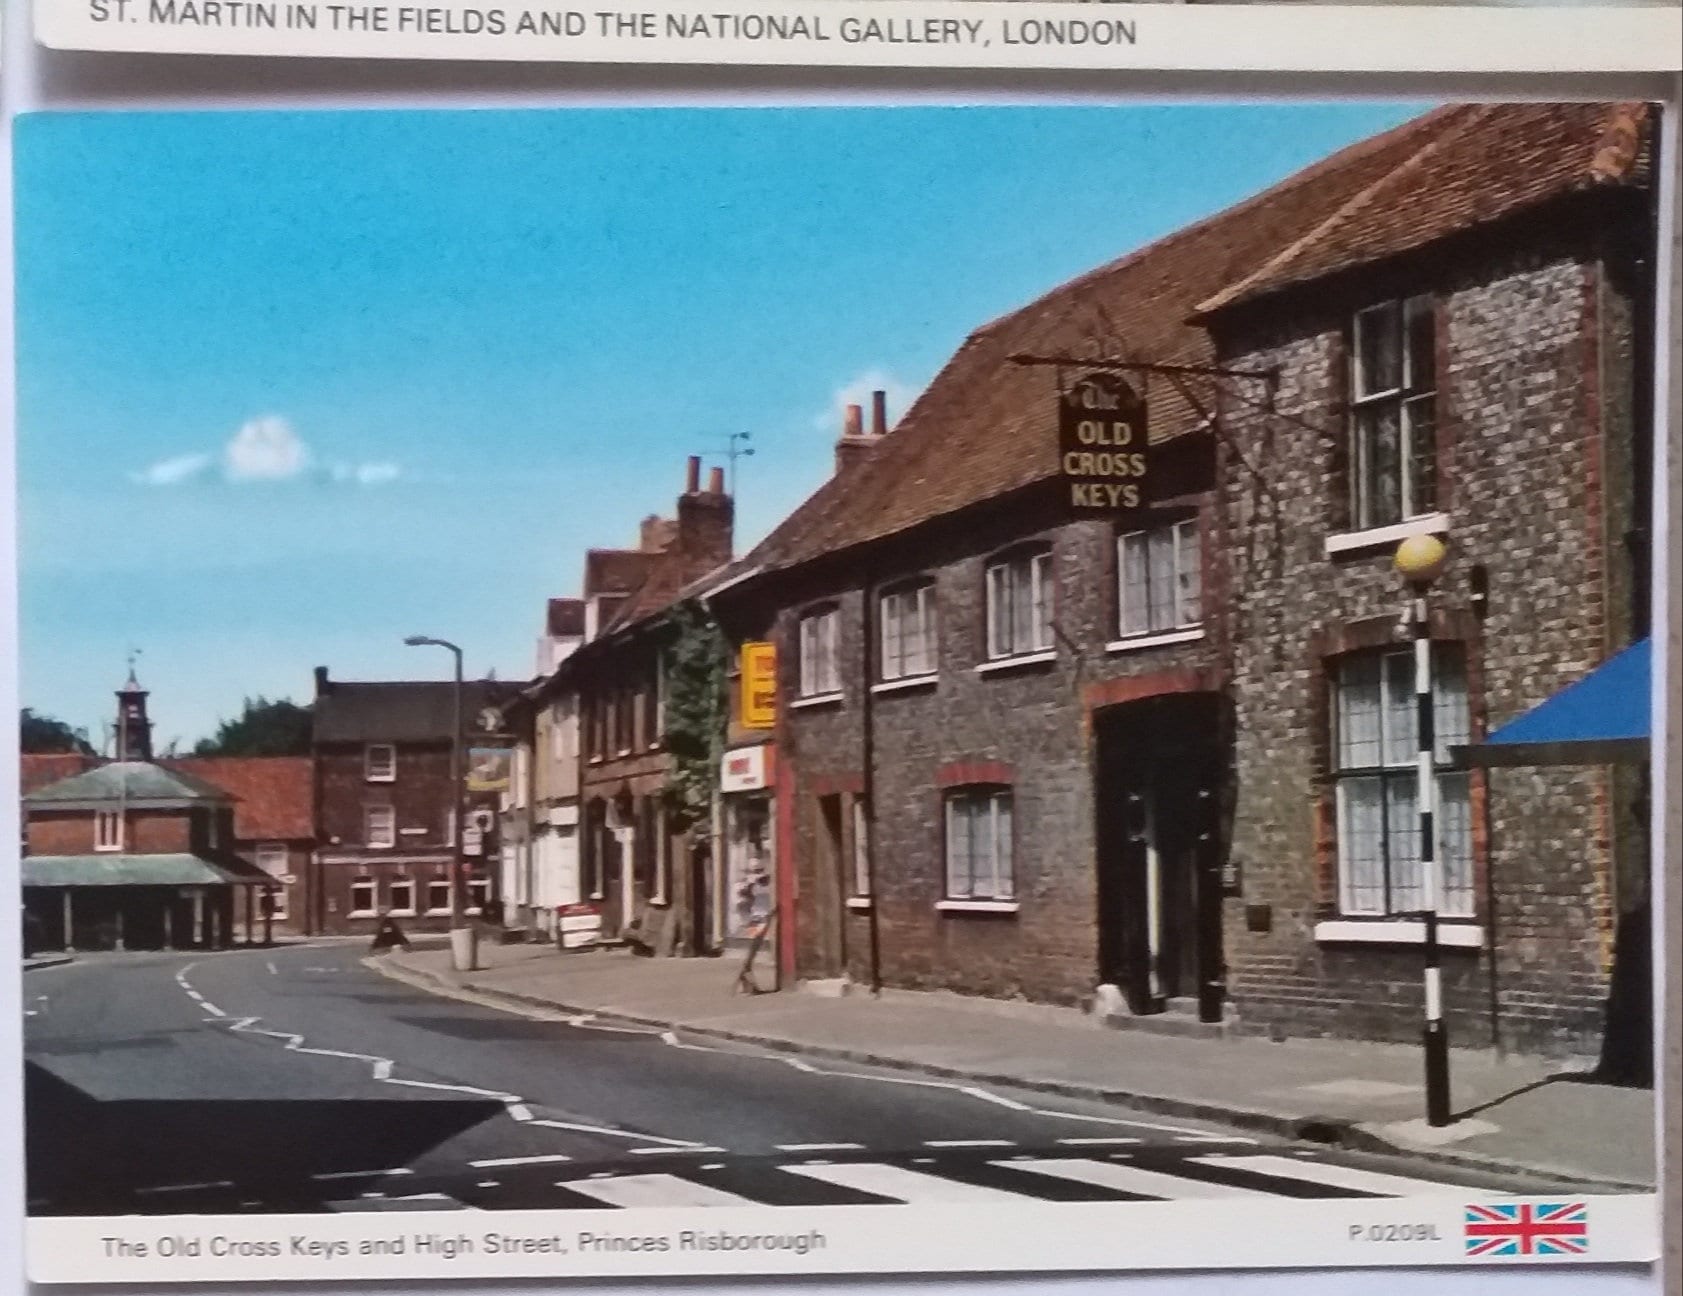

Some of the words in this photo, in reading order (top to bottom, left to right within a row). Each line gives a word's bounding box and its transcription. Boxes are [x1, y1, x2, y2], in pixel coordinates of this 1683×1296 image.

[89, 0, 138, 24] ST.
[148, 0, 276, 29] MARTIN
[286, 6, 316, 31] IN
[326, 6, 387, 32] THE
[399, 8, 505, 36] FIELDS
[515, 12, 586, 37] AND
[595, 13, 657, 38] THE
[667, 14, 830, 41] NATIONAL
[840, 18, 992, 48] GALLERY,
[1003, 20, 1138, 46] LONDON
[1077, 420, 1132, 446] OLD
[1063, 451, 1147, 477] CROSS
[1071, 483, 1140, 508] KEYS
[102, 1236, 148, 1258] The
[157, 1236, 200, 1257] Old
[209, 1236, 281, 1257] Cross
[289, 1235, 349, 1260] Keys
[358, 1235, 405, 1255] and
[414, 1233, 474, 1259] High
[483, 1233, 568, 1256] Street,
[578, 1232, 670, 1252] Princes
[679, 1230, 826, 1255] Risborough
[1349, 1224, 1442, 1242] P.0209L
